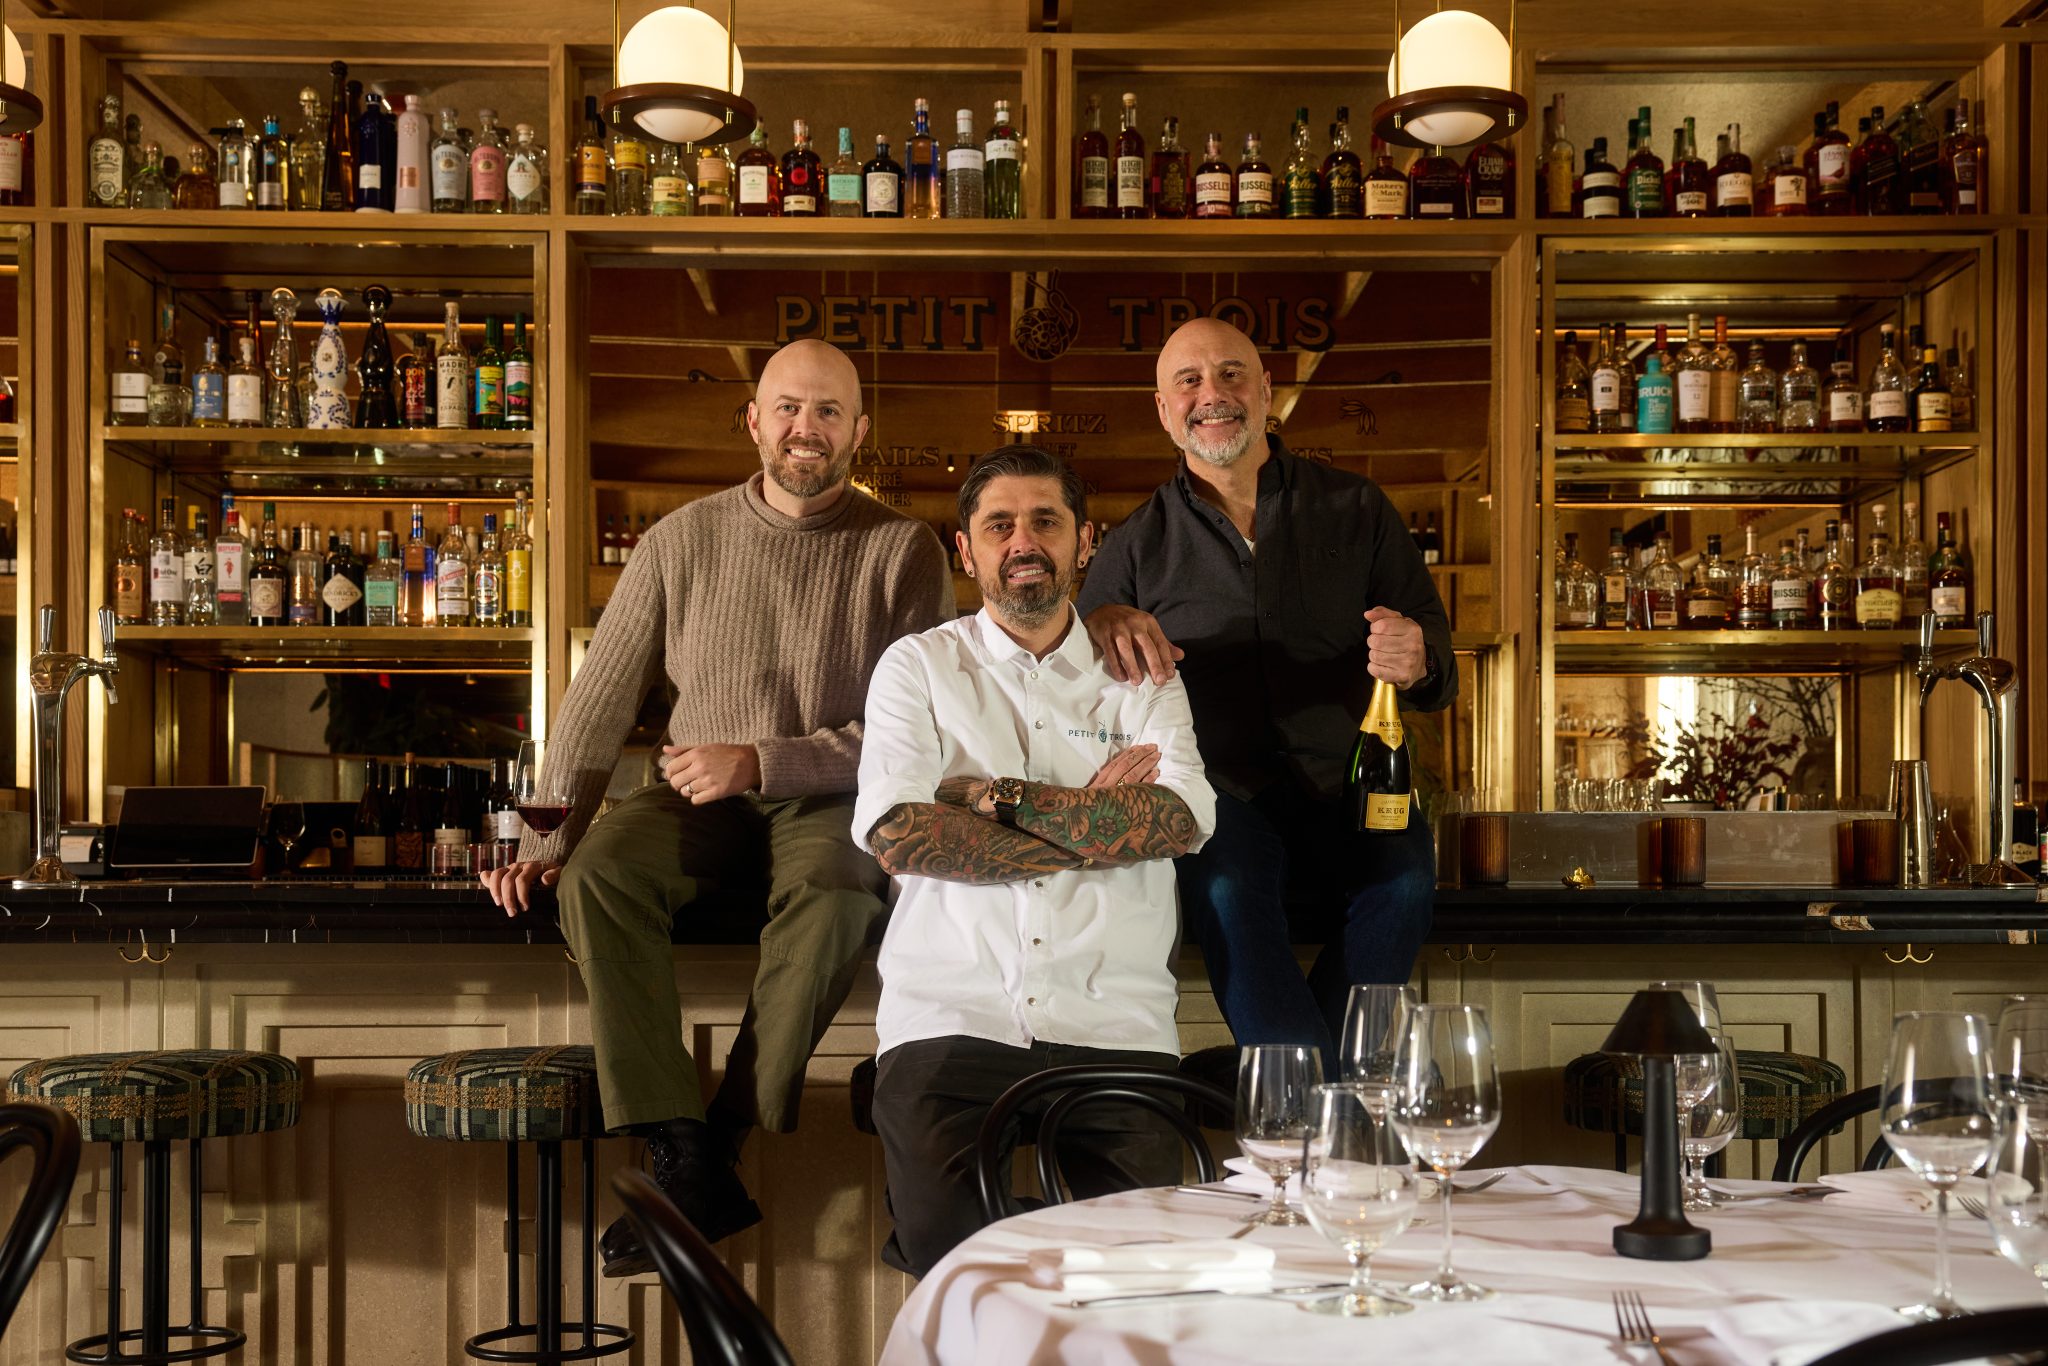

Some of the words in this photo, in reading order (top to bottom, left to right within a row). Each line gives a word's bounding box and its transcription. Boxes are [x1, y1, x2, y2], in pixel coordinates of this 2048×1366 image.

[1085, 160, 1106, 168] HIGH
[1121, 160, 1141, 168] HIGH
[1478, 156, 1503, 167] ELIJAH
[1478, 165, 1503, 175] CRAIG
[1255, 203, 1261, 212] 6
[775, 295, 994, 348] PETIT
[1108, 297, 1332, 349] TROIS
[992, 413, 1107, 434] SPRITZ
[854, 446, 940, 466] TAILS
[195, 557, 214, 575] 白
[1068, 729, 1095, 739] PETIT
[1109, 733, 1132, 741] TROIS
[1377, 807, 1404, 815] KRUG
